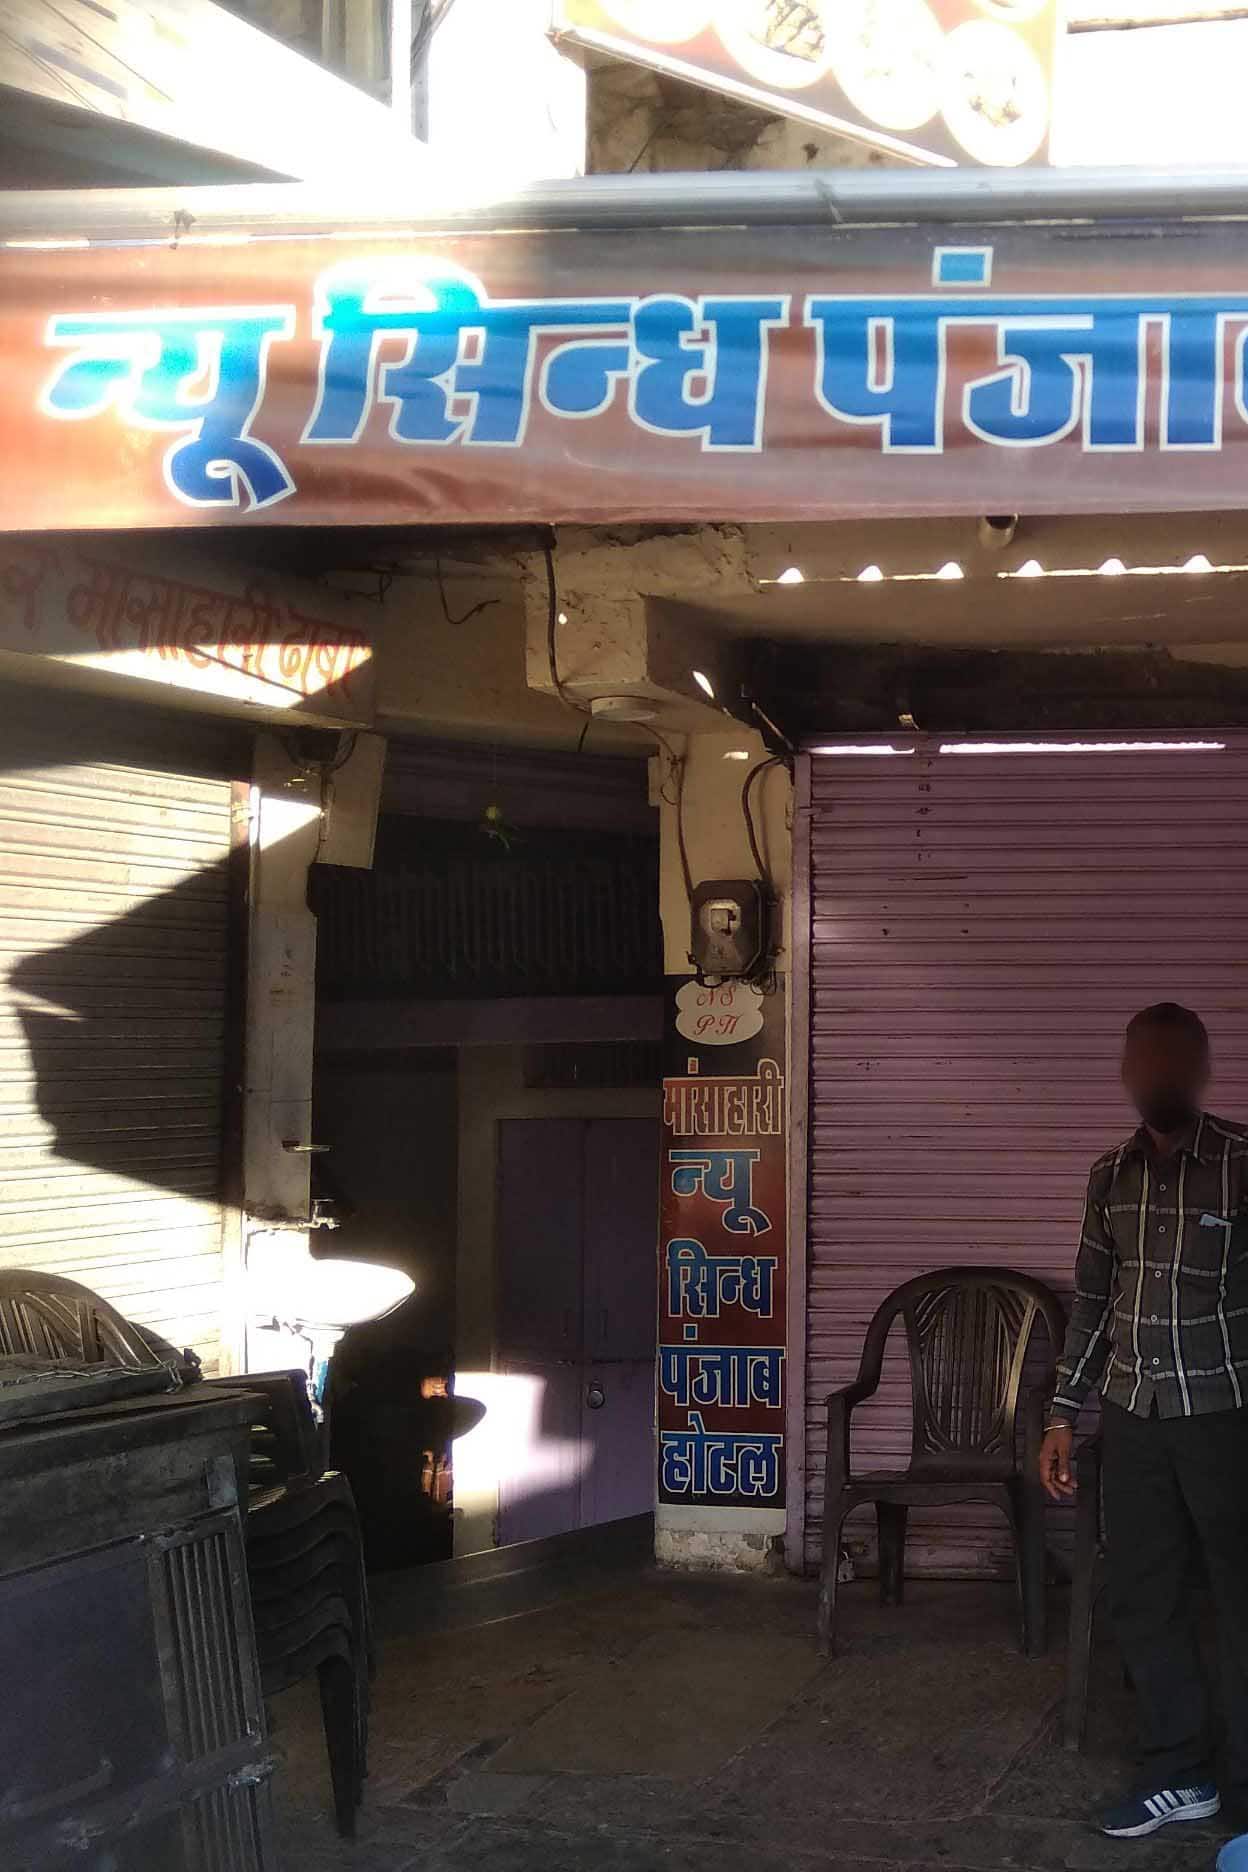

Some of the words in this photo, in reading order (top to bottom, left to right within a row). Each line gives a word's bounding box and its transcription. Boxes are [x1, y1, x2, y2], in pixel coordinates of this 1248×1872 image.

[42, 305, 296, 511] न्यू
[300, 257, 793, 453] सिन्ध
[663, 1057, 785, 1136] मांसाहारी
[669, 1148, 772, 1237] न्यू
[666, 1237, 778, 1318] सिन्ध
[658, 1322, 786, 1408] पंजाब
[660, 1411, 783, 1496] होटल
